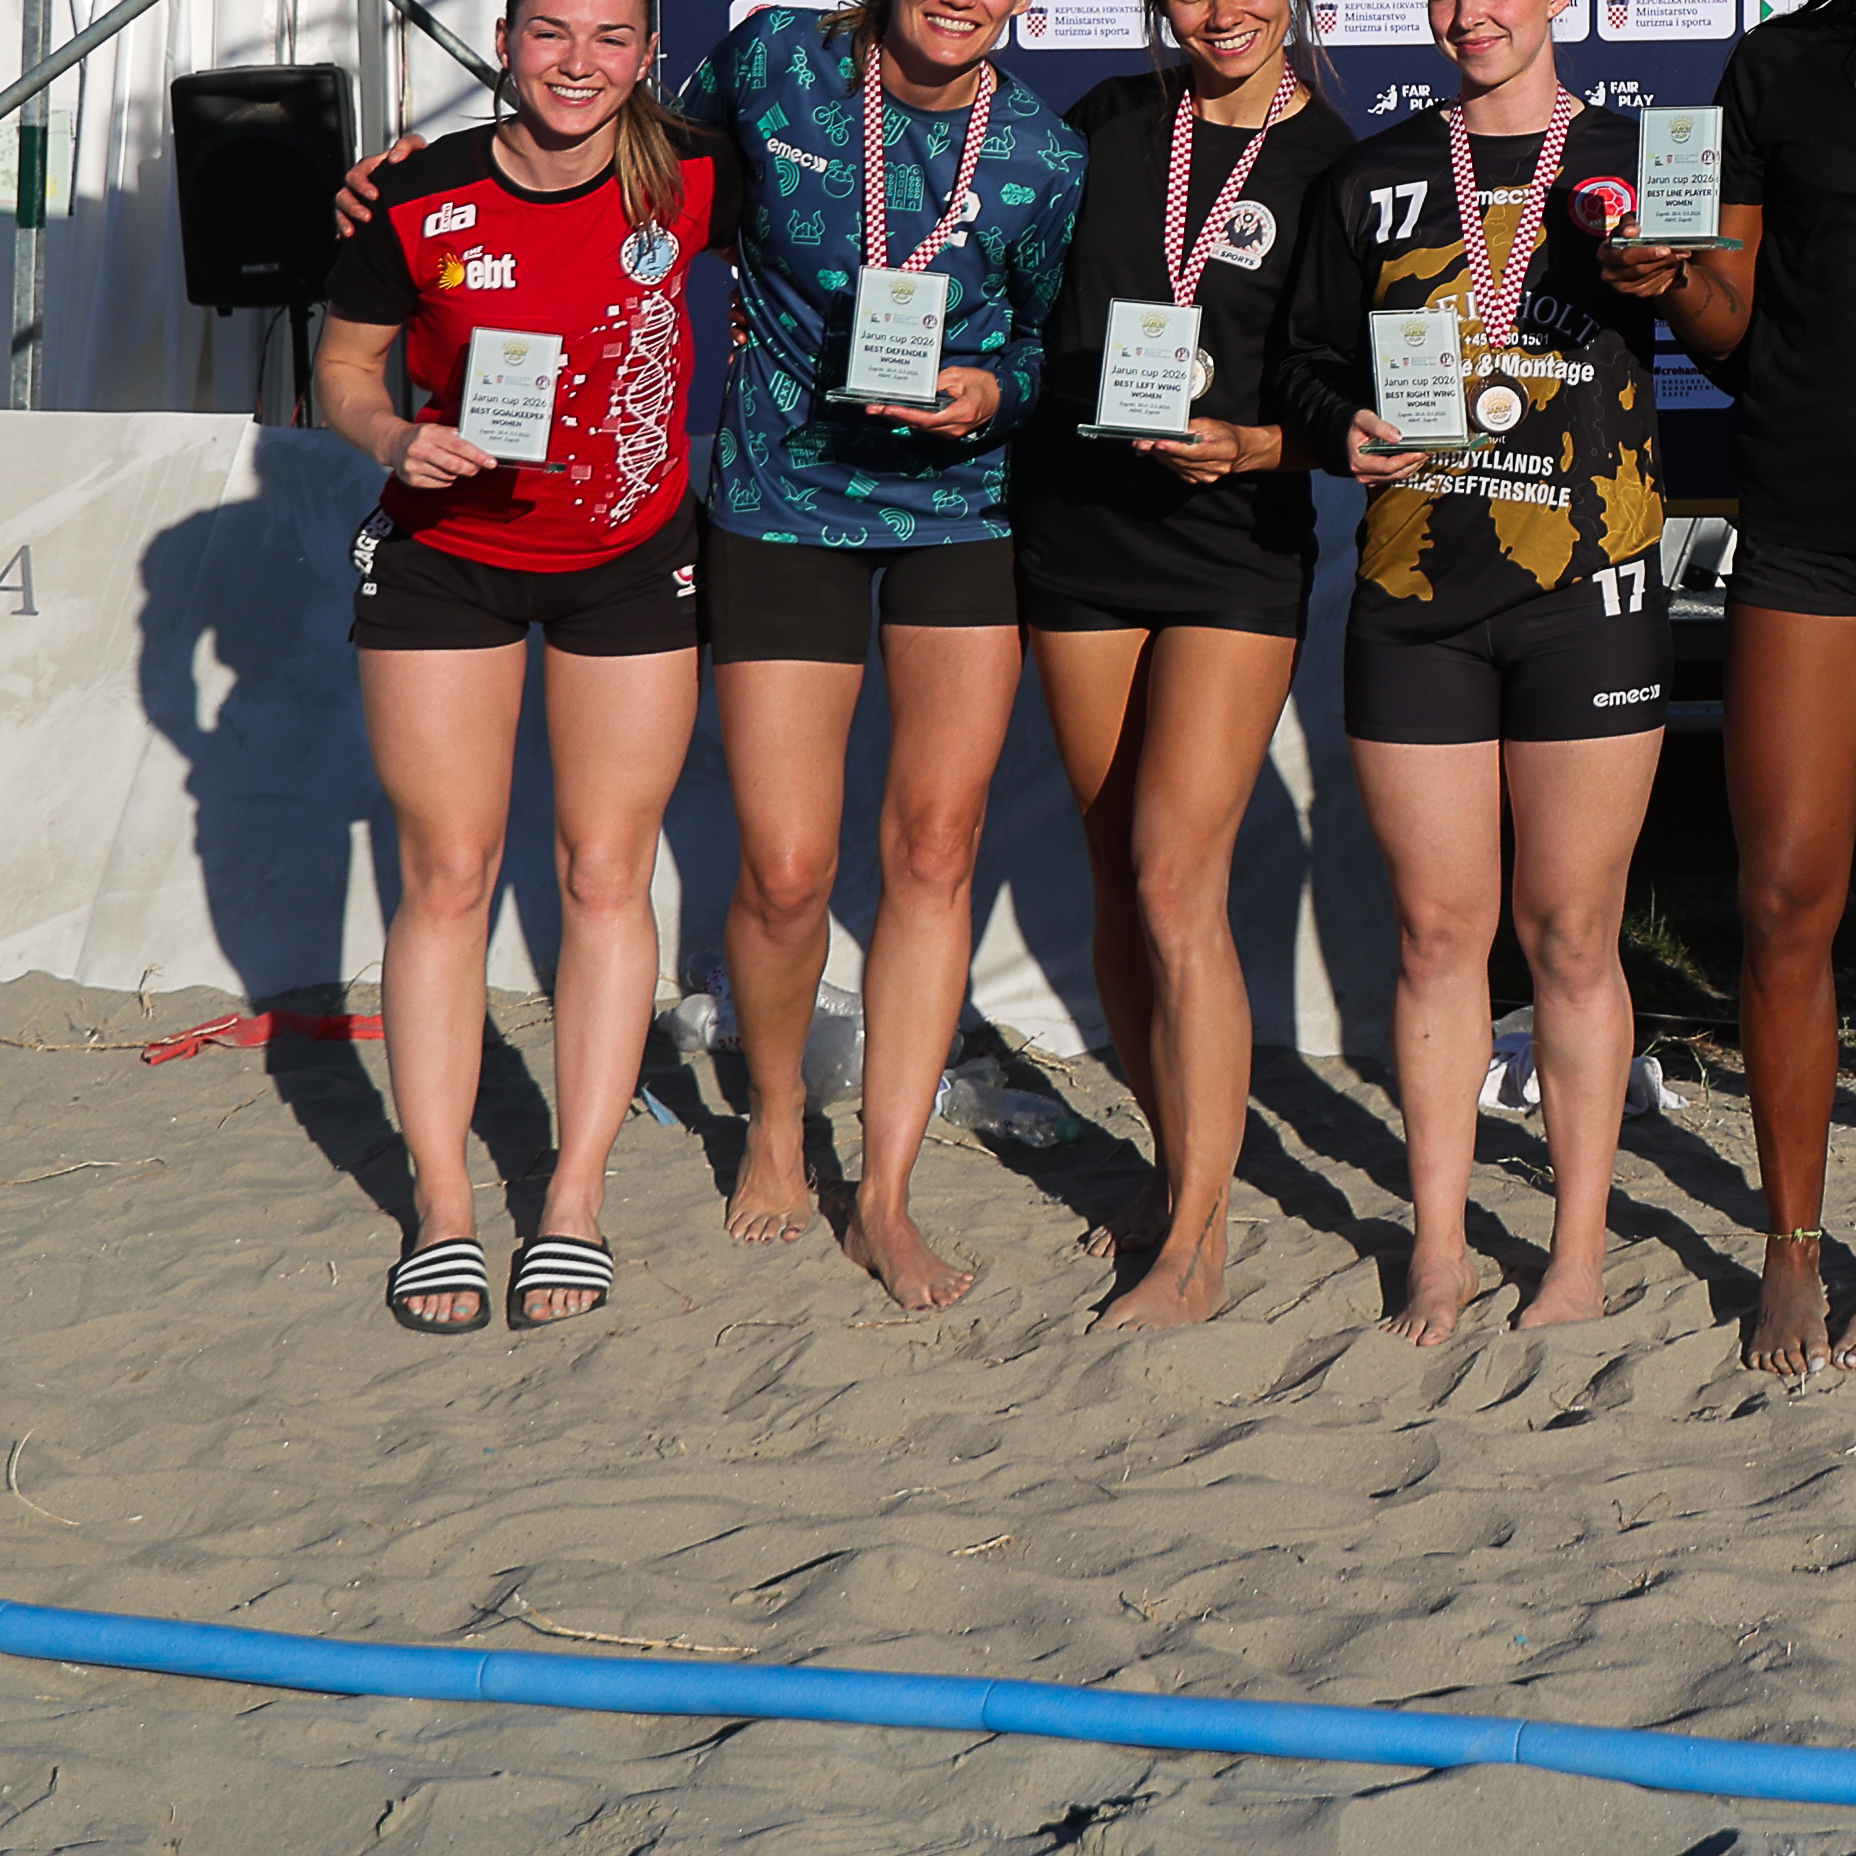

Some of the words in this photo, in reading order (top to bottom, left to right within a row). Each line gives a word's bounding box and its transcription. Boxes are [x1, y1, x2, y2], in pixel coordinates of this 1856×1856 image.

[1402, 85, 1430, 97] FAIR
[1611, 82, 1638, 93] FAIR
[1619, 95, 1653, 107] PLAY
[767, 137, 814, 167] emec
[1647, 176, 1670, 184] Jarun
[1673, 176, 1689, 184] cup
[1692, 174, 1714, 183] 2026
[1371, 181, 1428, 243] 17
[1220, 250, 1255, 266] SPORTS
[466, 254, 516, 289] ebt
[1111, 366, 1137, 376] Jarun
[1142, 369, 1158, 378] cup
[1162, 369, 1187, 379] 2026
[1501, 353, 1595, 385] Montage
[1592, 559, 1646, 616] 17
[1593, 685, 1651, 707] emec
